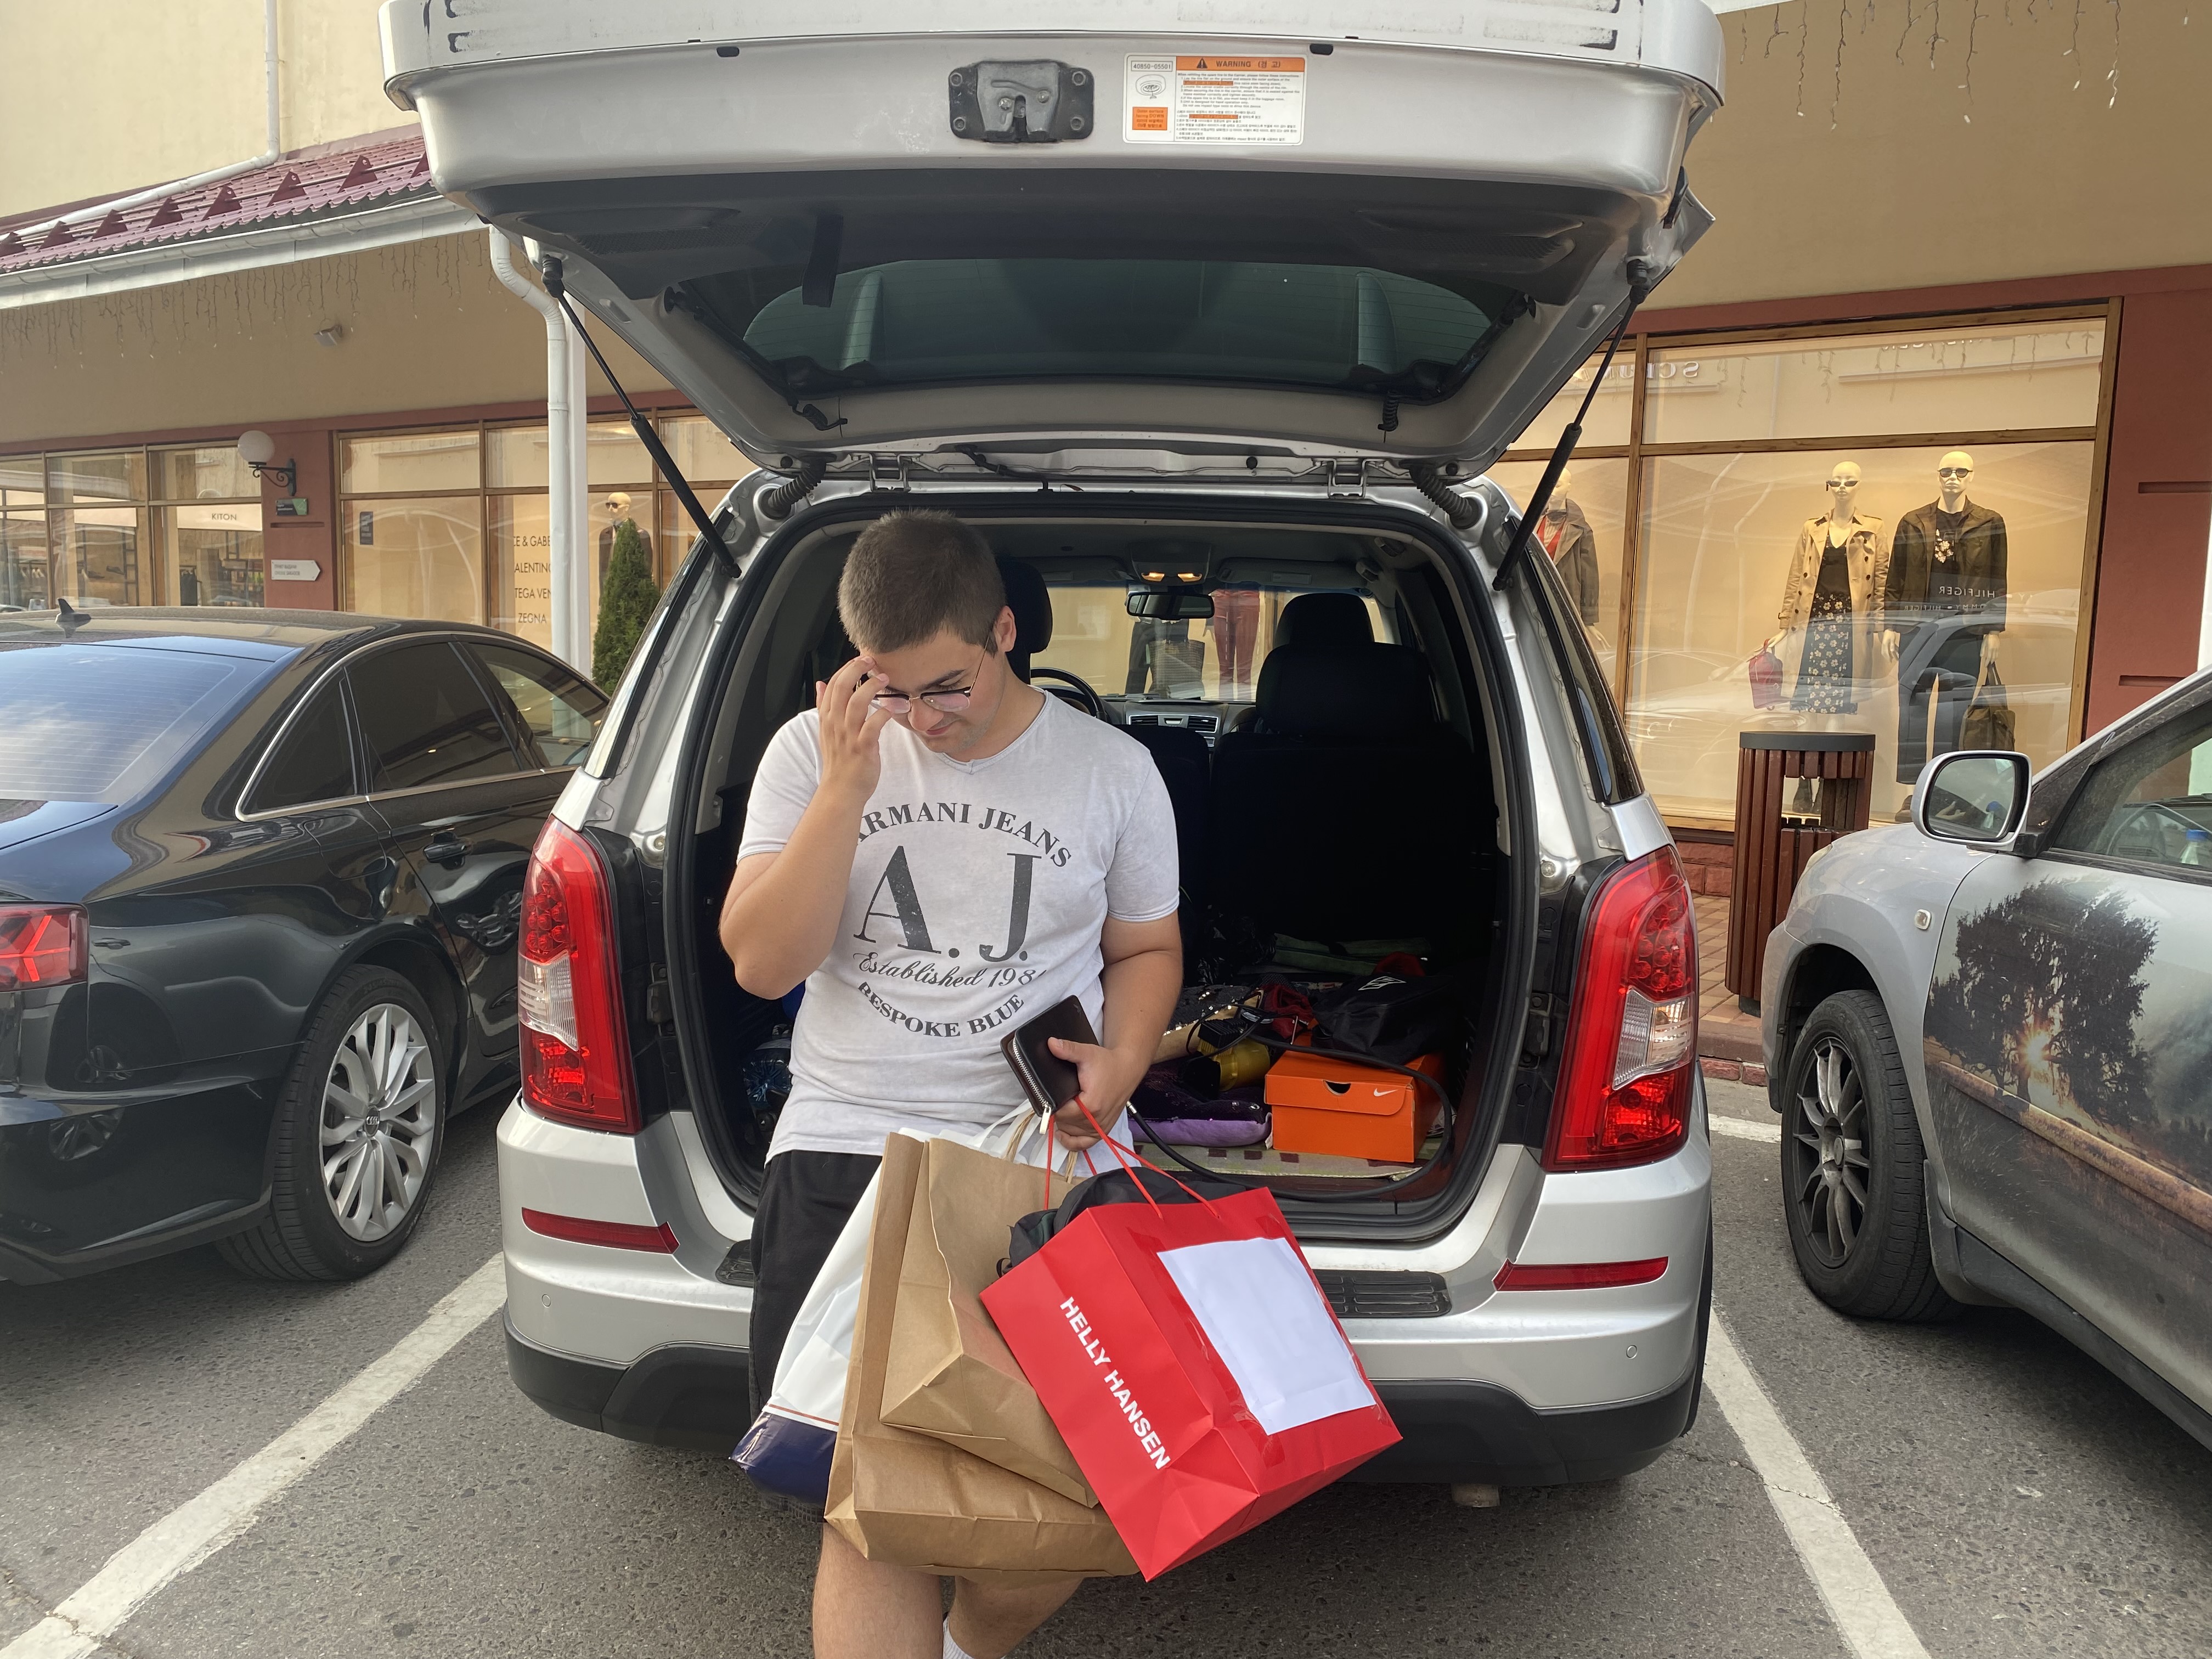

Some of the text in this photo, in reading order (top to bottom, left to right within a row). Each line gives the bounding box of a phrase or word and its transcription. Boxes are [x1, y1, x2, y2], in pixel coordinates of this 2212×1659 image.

[211, 513, 237, 521] KITON
[518, 612, 547, 623] ZEGNA
[978, 807, 1071, 867] JEANS
[853, 952, 988, 988] Established
[967, 994, 1025, 1035] BLUE
[1059, 1296, 1171, 1470] HELLY HANSEN
